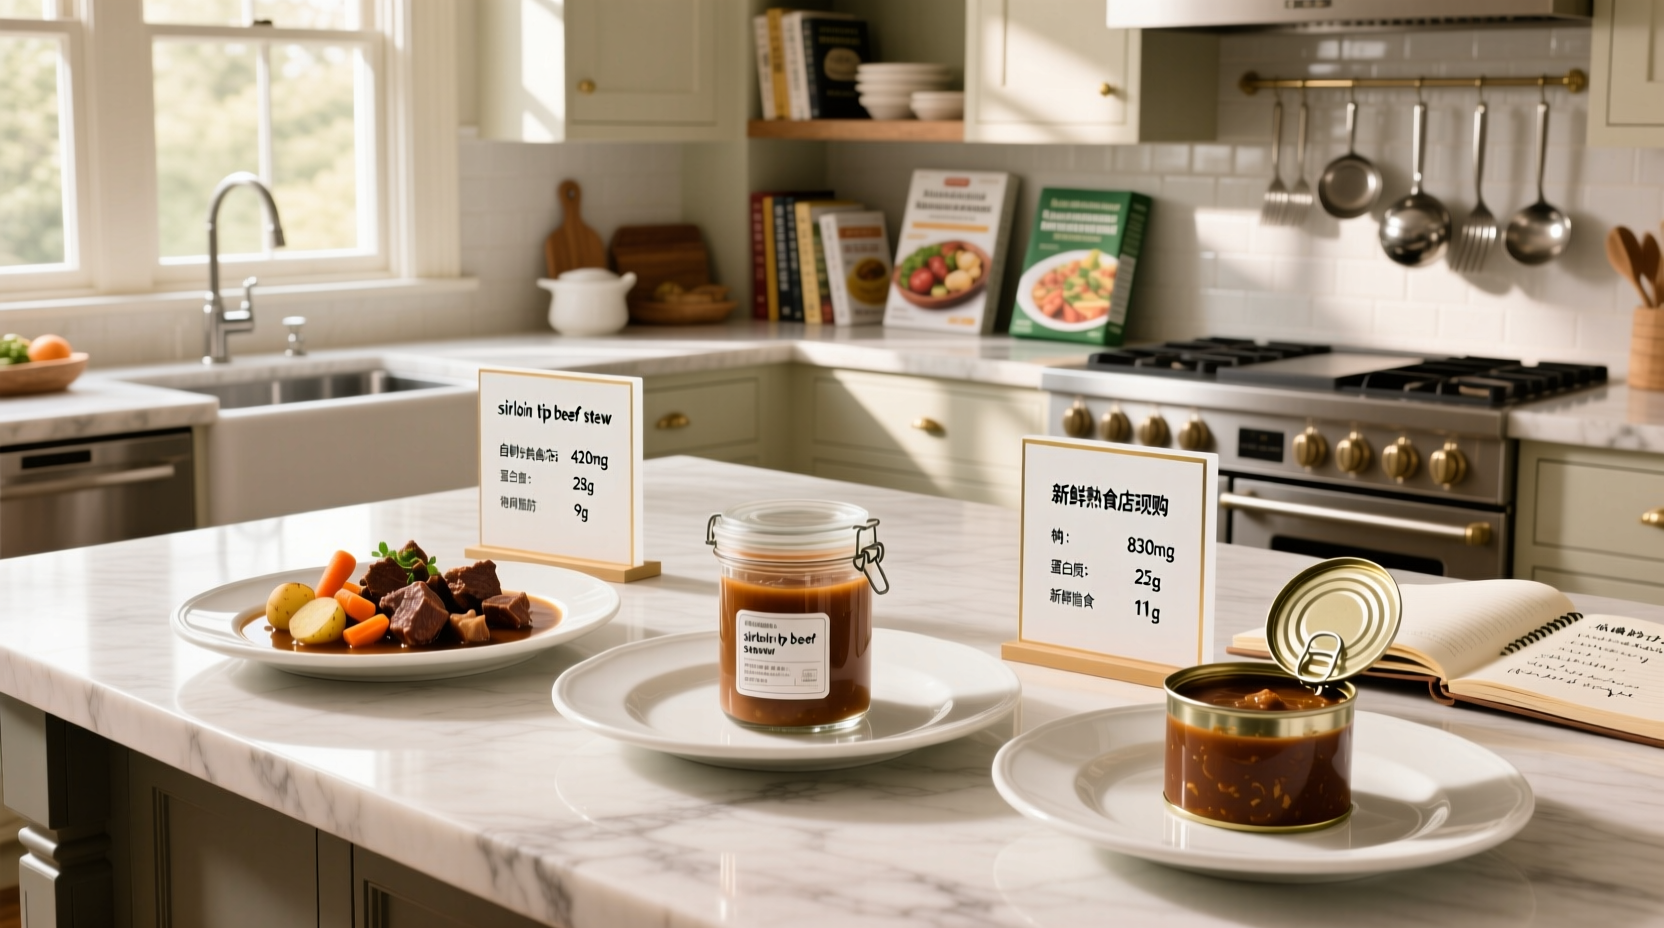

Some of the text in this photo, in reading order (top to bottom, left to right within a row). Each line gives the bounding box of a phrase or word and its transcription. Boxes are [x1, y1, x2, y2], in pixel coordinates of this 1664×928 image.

[498, 399, 612, 425] sirloin tip beef stew
[573, 503, 589, 523] 9g
[1126, 536, 1175, 563] 830mg
[1134, 568, 1161, 593] 25g
[1134, 599, 1161, 625] 11g
